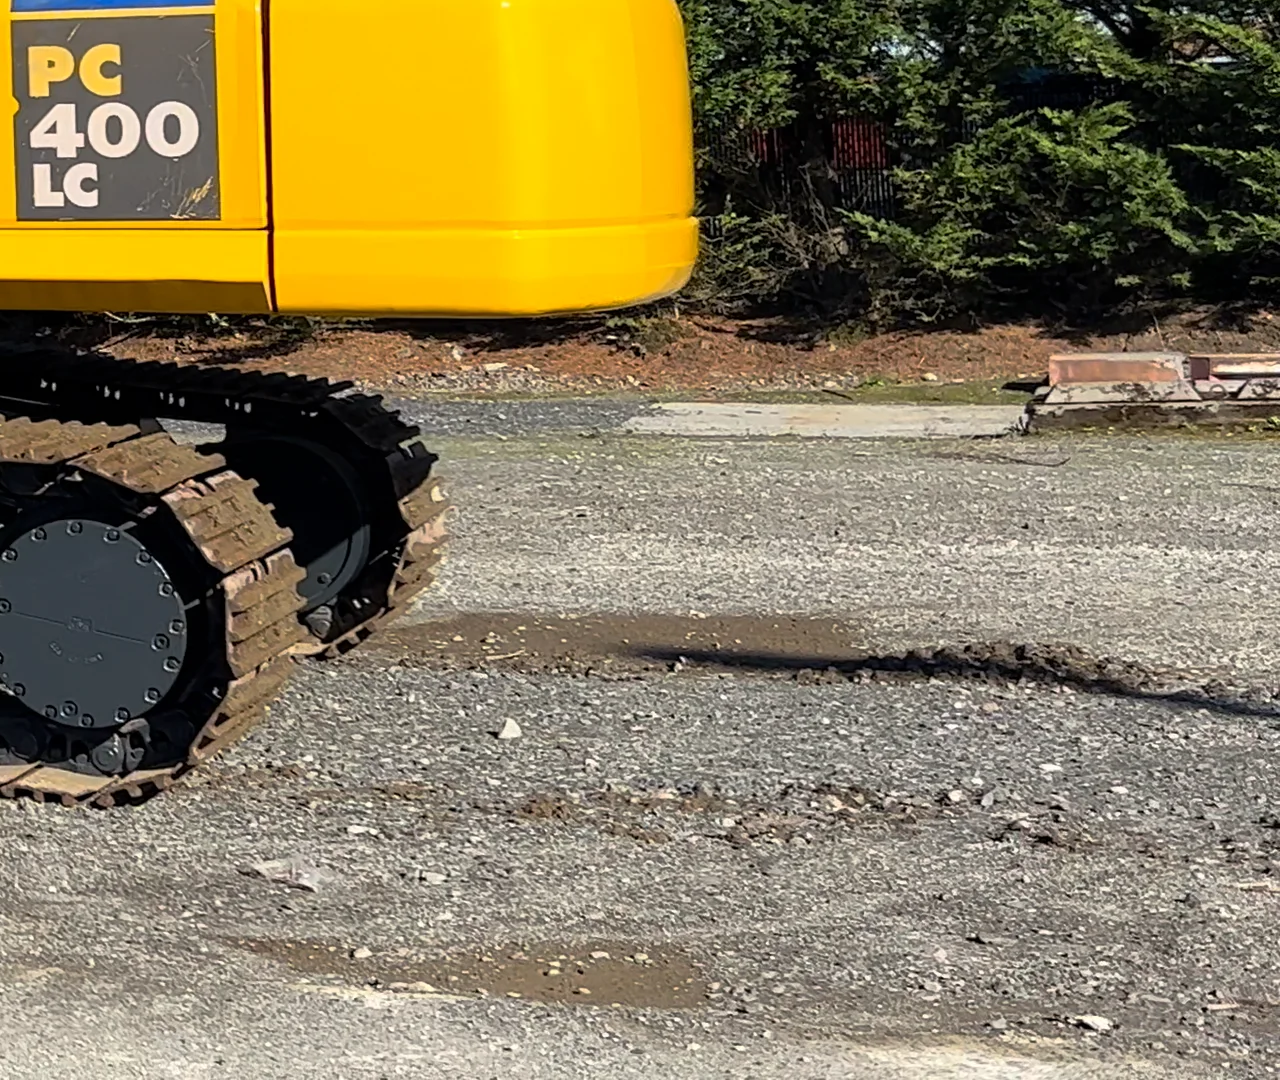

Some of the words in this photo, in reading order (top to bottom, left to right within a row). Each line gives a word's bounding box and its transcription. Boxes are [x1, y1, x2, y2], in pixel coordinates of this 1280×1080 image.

[27, 43, 122, 98] PC
[29, 100, 200, 159] 400
[32, 162, 99, 208] LC
